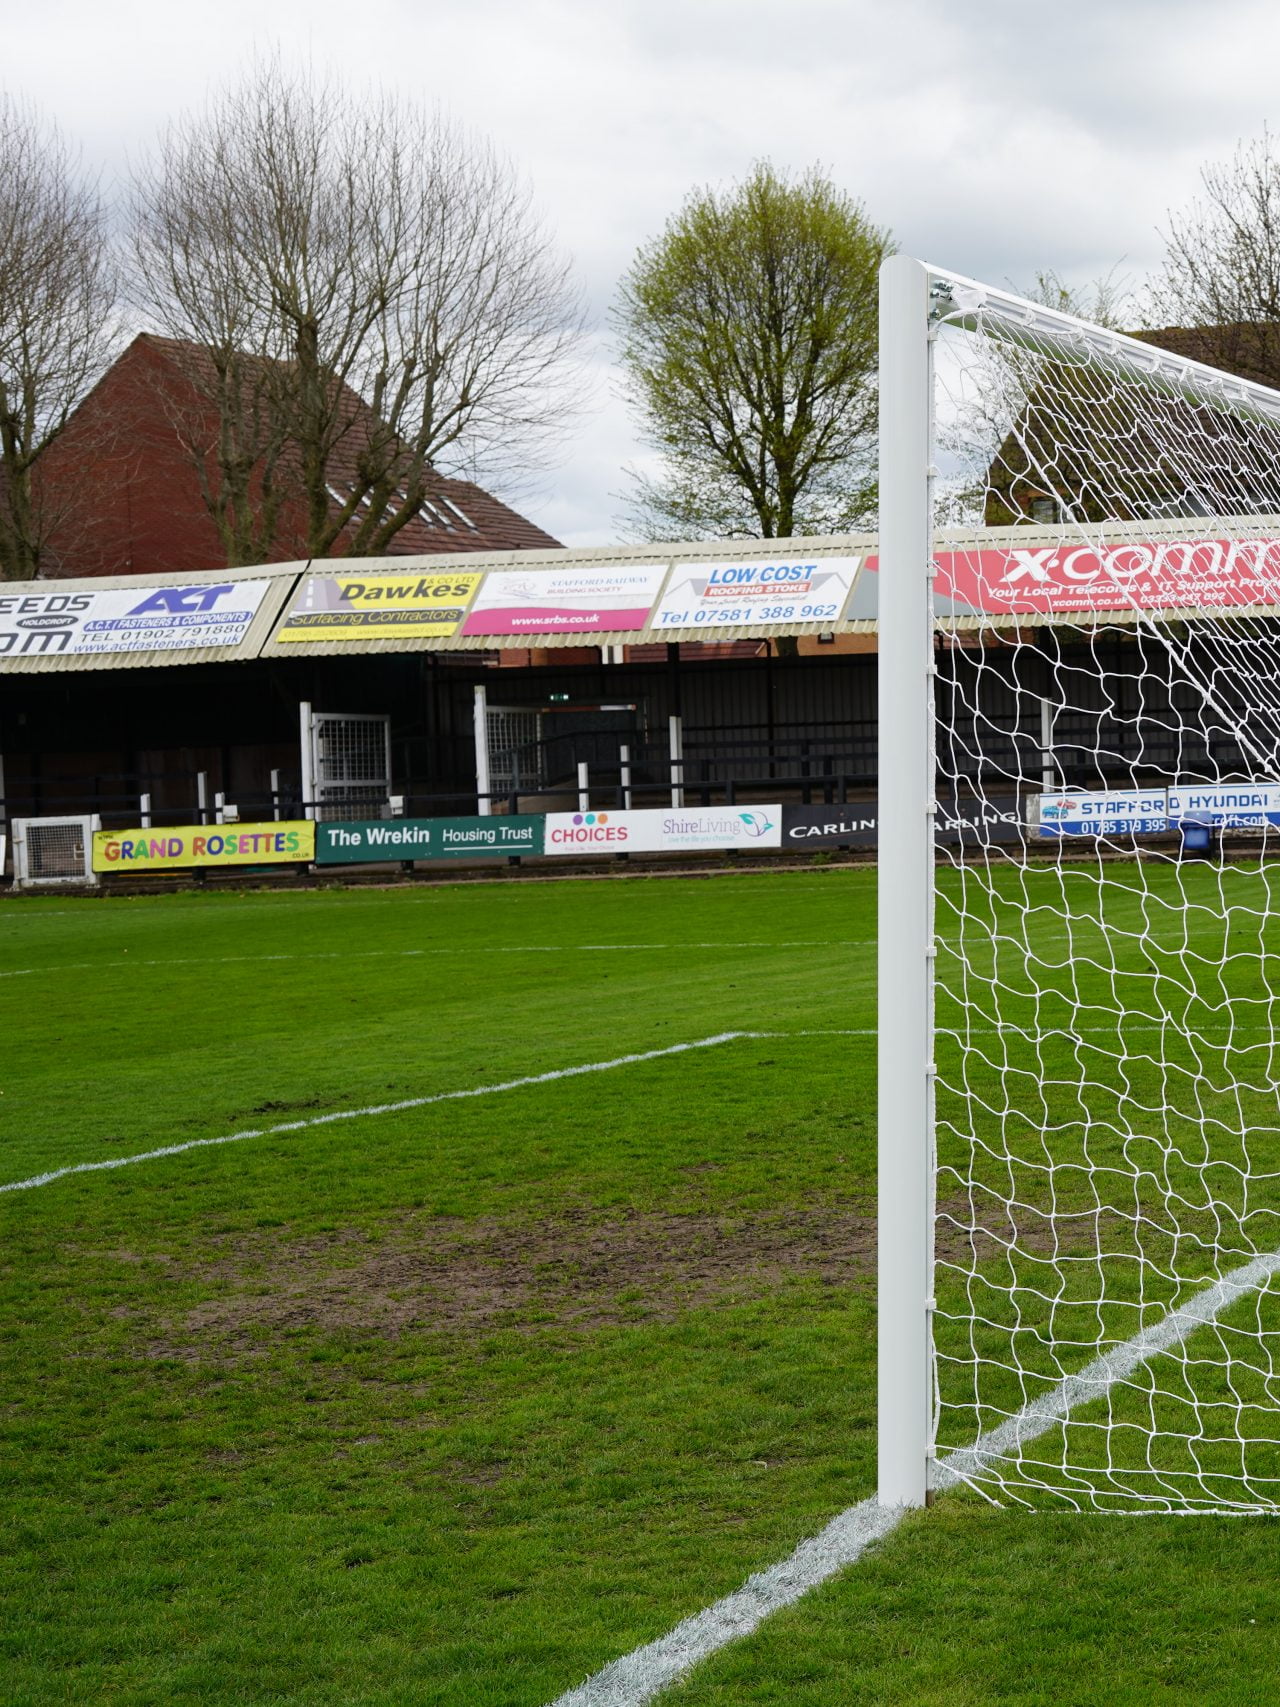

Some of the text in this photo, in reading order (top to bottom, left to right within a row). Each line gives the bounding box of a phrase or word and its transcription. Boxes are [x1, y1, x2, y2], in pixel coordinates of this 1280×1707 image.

[551, 576, 649, 587] STAFFORD RAILWAY
[709, 565, 817, 584] LOW COST
[339, 579, 472, 600] Dawkes
[547, 586, 623, 595] BUILDING SOCIETY
[709, 583, 808, 595] ROOFING STOKE
[989, 587, 1020, 598] Your
[1023, 585, 1062, 597] Local
[1142, 582, 1151, 591] &
[1158, 581, 1175, 591] IT
[1177, 579, 1235, 593] Support
[125, 585, 235, 616] ACT
[1052, 596, 1128, 607] xcomm.co.uk
[22, 618, 73, 627] HOLDCROFT
[174, 616, 180, 626] &
[291, 610, 458, 626] Surfacing Contractors
[511, 614, 599, 626] www.srbs.co.uk
[661, 604, 837, 624] Tel 07581 388 962
[81, 624, 245, 643] TEL 01902 791880
[74, 635, 240, 653] www.actfasteners.co.uk
[1082, 797, 1180, 814] STAFFORD
[1189, 794, 1268, 808] HYUNDAI
[663, 817, 741, 836] ShireLiving
[789, 818, 878, 838] CARLIN
[934, 812, 1017, 832] ARLING
[1081, 819, 1166, 833] 01785 319 395
[328, 826, 533, 846] The Wrekin Housing Trust
[551, 827, 628, 843] CHOICES
[104, 832, 299, 861] GRAND ROSETTES
